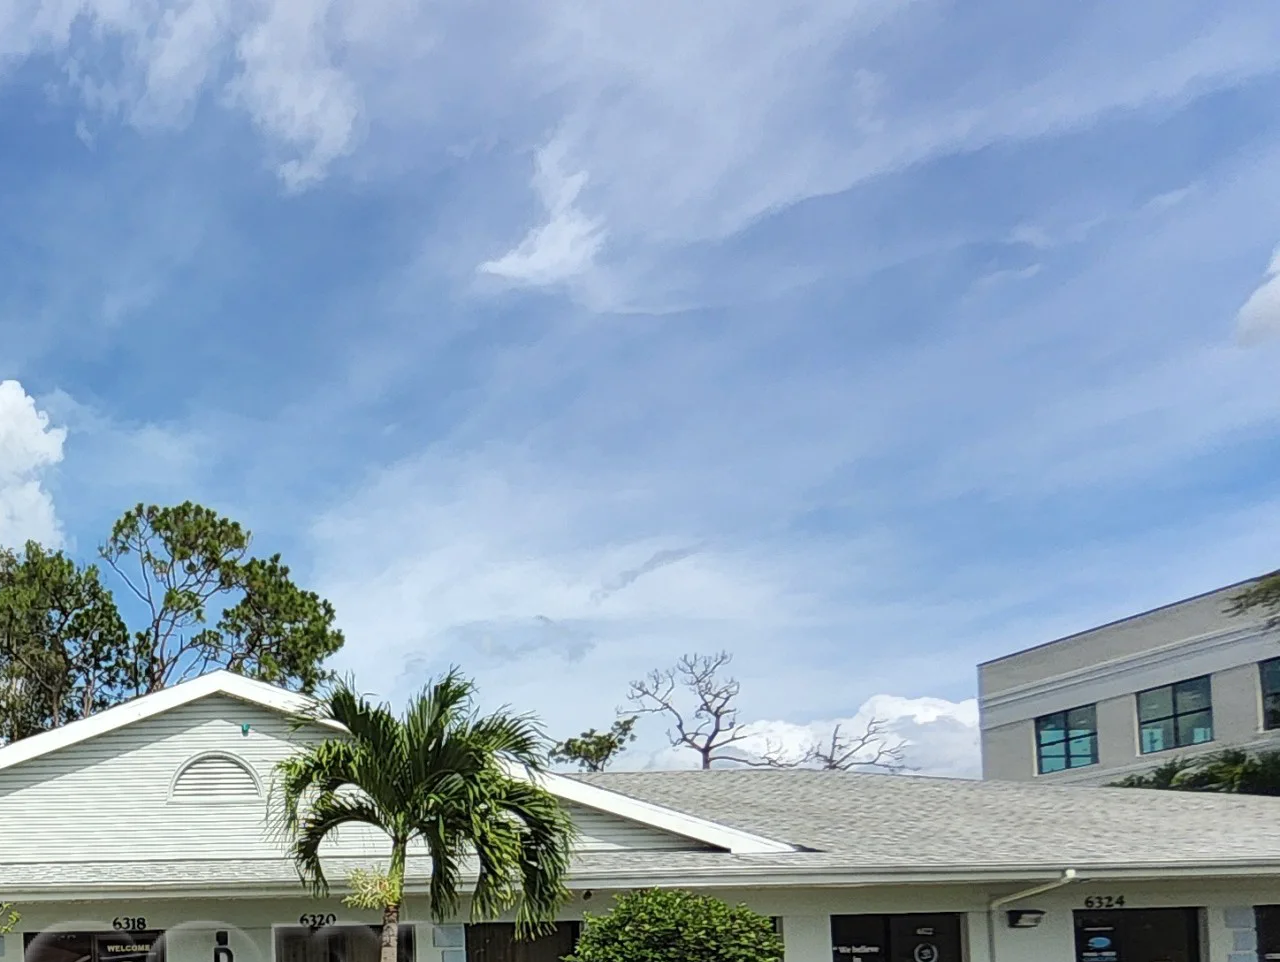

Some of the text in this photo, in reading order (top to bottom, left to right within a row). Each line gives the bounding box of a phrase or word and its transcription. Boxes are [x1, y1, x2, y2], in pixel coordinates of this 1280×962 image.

[1084, 895, 1125, 908] 6324
[112, 916, 147, 930] 6318
[300, 913, 336, 927] 6320
[107, 944, 151, 952] WELCOME
